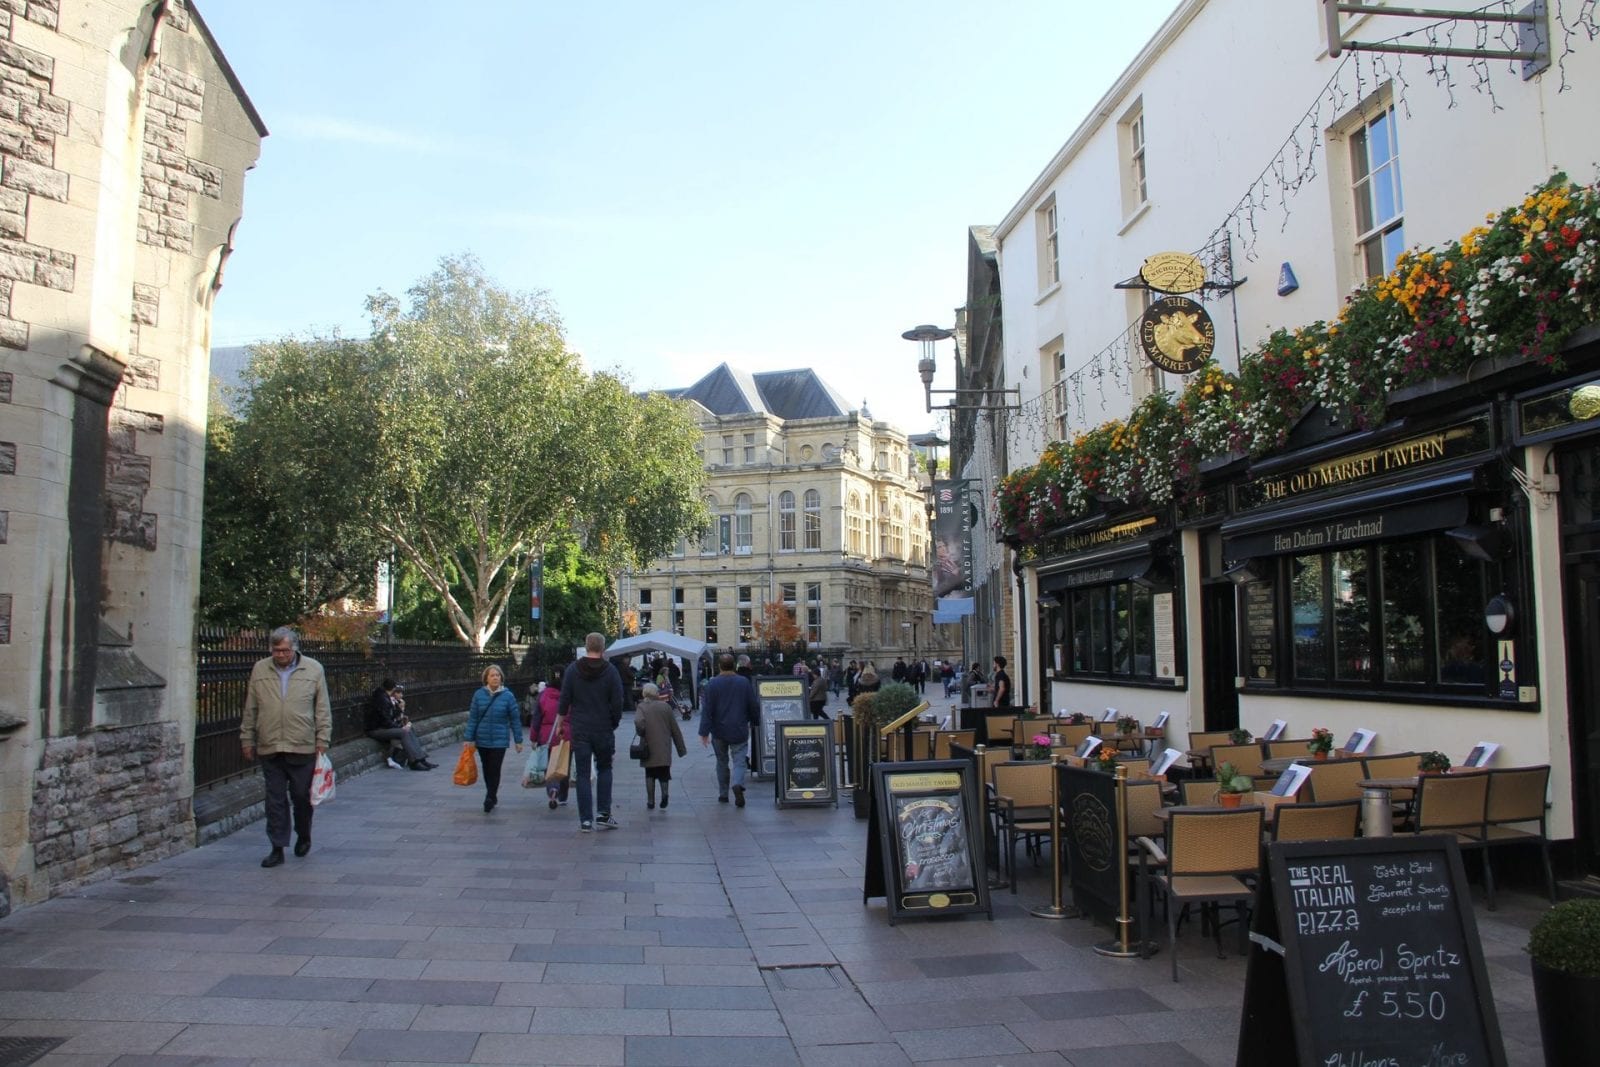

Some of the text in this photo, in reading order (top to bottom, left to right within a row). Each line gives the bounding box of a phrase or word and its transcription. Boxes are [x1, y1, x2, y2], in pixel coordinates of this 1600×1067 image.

[1164, 298, 1190, 307] THE
[1144, 320, 1214, 371] OLD MARKET TAVERN
[1263, 437, 1445, 499] THE OLD MARKET TAVERN
[940, 506, 953, 514] 1891
[961, 487, 972, 592] CARDIFF MARKET
[1274, 515, 1383, 551] Hen Dafarn Y Farchnad
[901, 815, 959, 839] Christmas
[1288, 864, 1353, 885] THE REAL
[1395, 877, 1413, 887] and
[1294, 886, 1356, 908] ITALIAN
[1367, 884, 1413, 902] Gourmet
[1382, 902, 1421, 916] accepted
[1319, 940, 1461, 982] Aperol Spritz
[1343, 990, 1369, 1017] £
